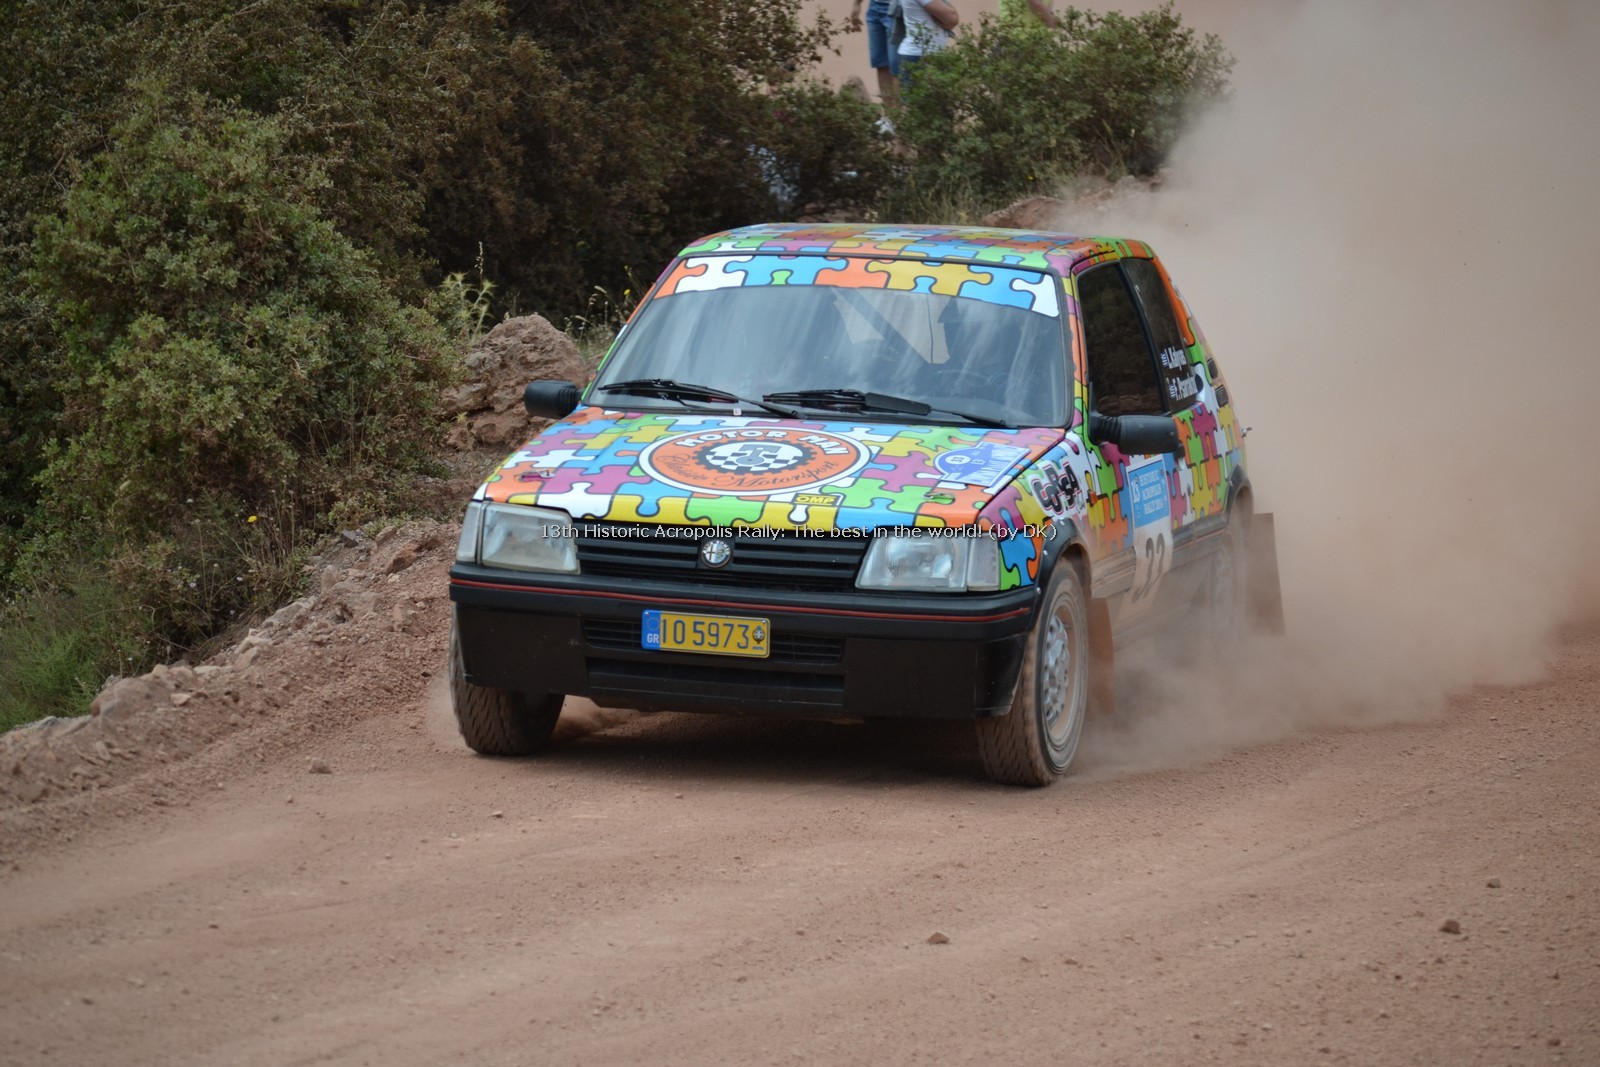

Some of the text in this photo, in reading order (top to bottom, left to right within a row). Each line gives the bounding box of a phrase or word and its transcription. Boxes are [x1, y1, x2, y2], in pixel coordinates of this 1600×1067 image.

[674, 430, 850, 455] MOTOR MAN
[795, 495, 836, 504] OMP
[647, 632, 660, 644] GR
[693, 621, 750, 650] 5973
